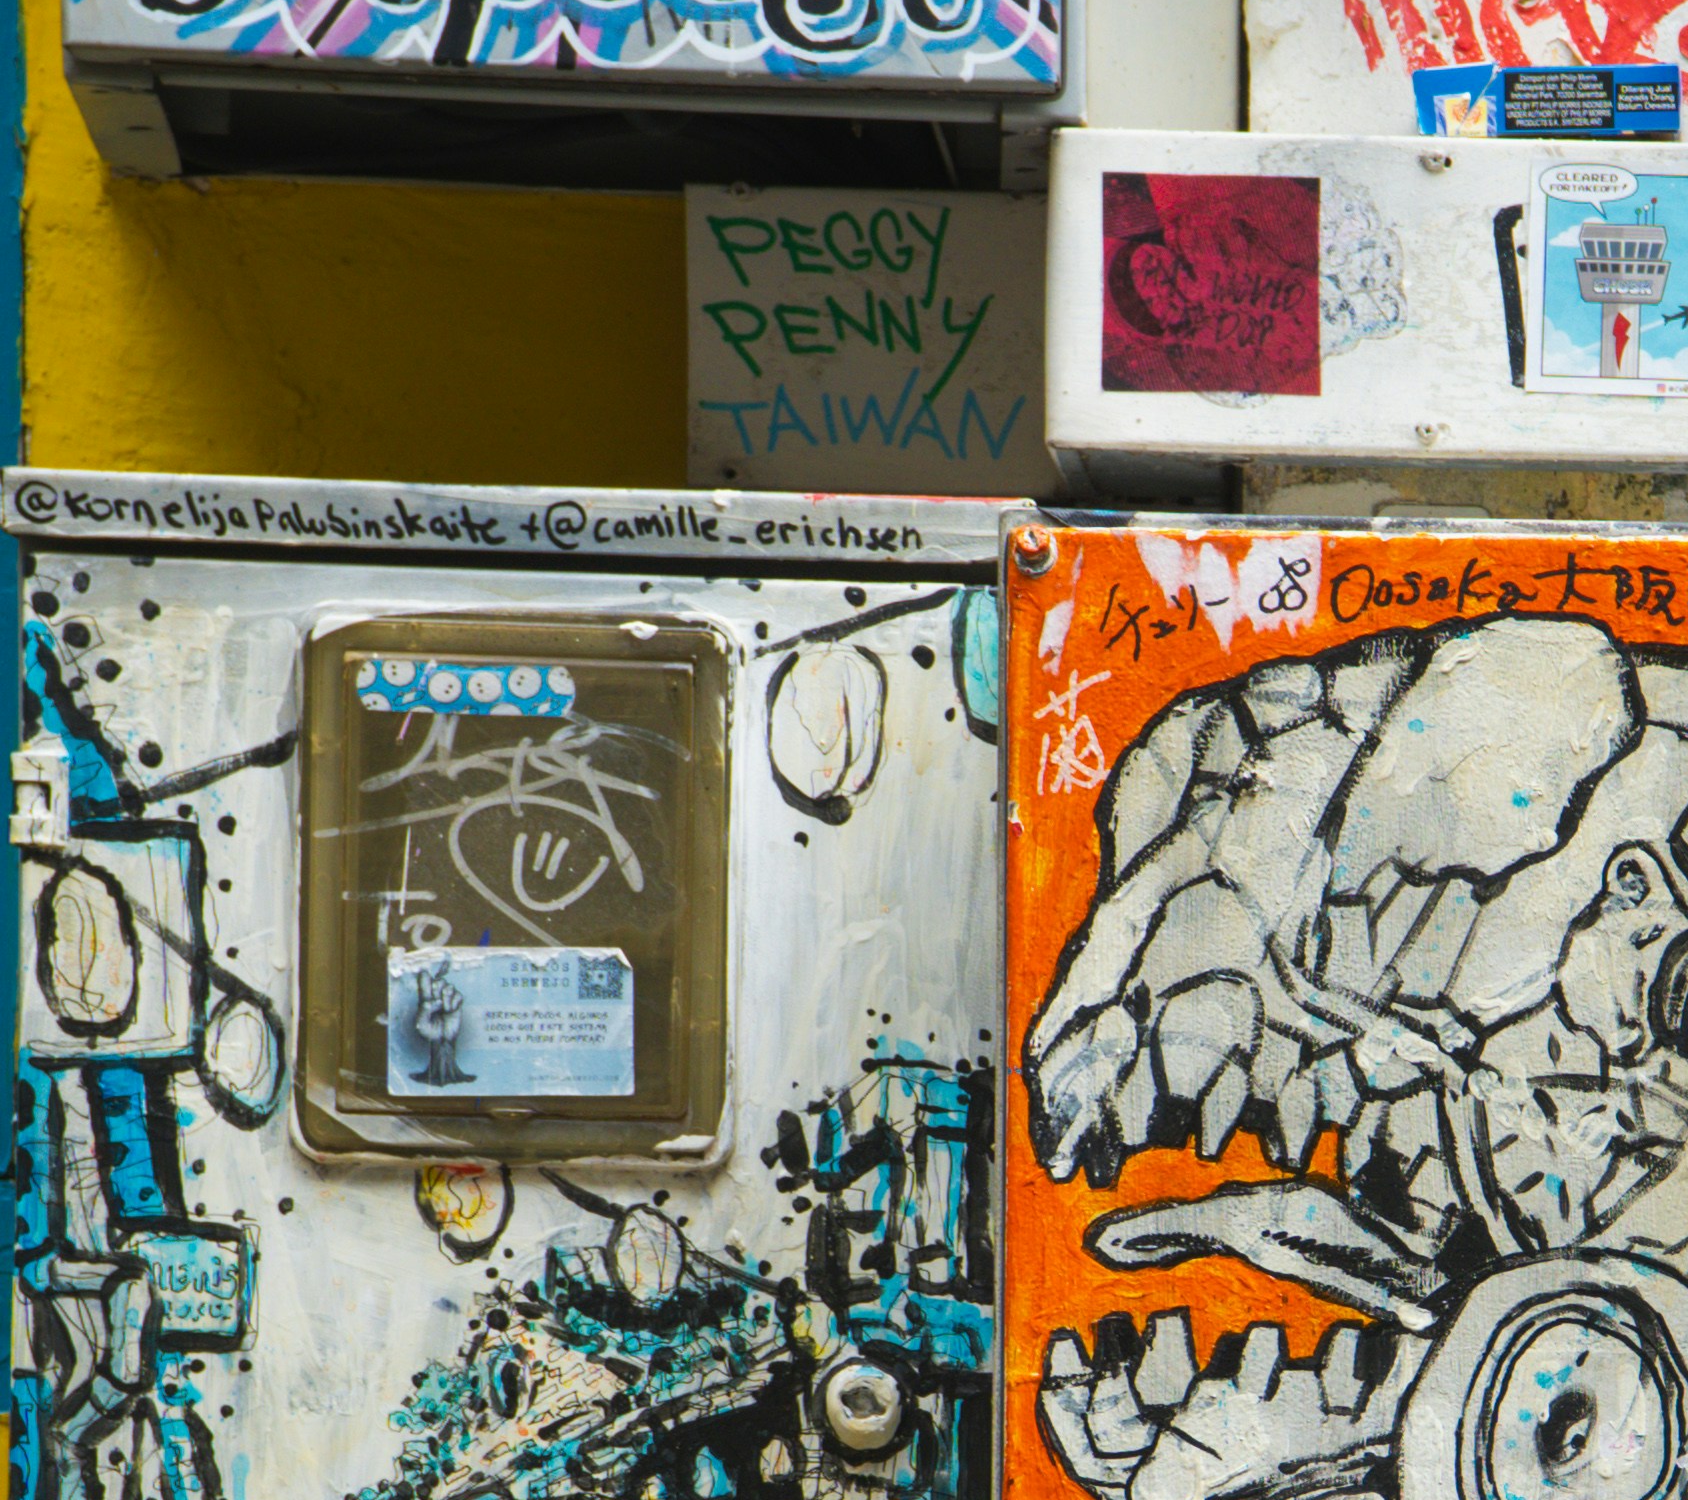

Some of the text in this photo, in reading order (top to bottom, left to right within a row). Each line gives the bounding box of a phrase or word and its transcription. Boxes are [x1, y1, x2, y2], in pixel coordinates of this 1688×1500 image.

[1556, 172, 1619, 184] CLEARED
[709, 205, 950, 304] PEGGY
[704, 294, 993, 400] PENNY
[700, 368, 1025, 460] TAIWAN
